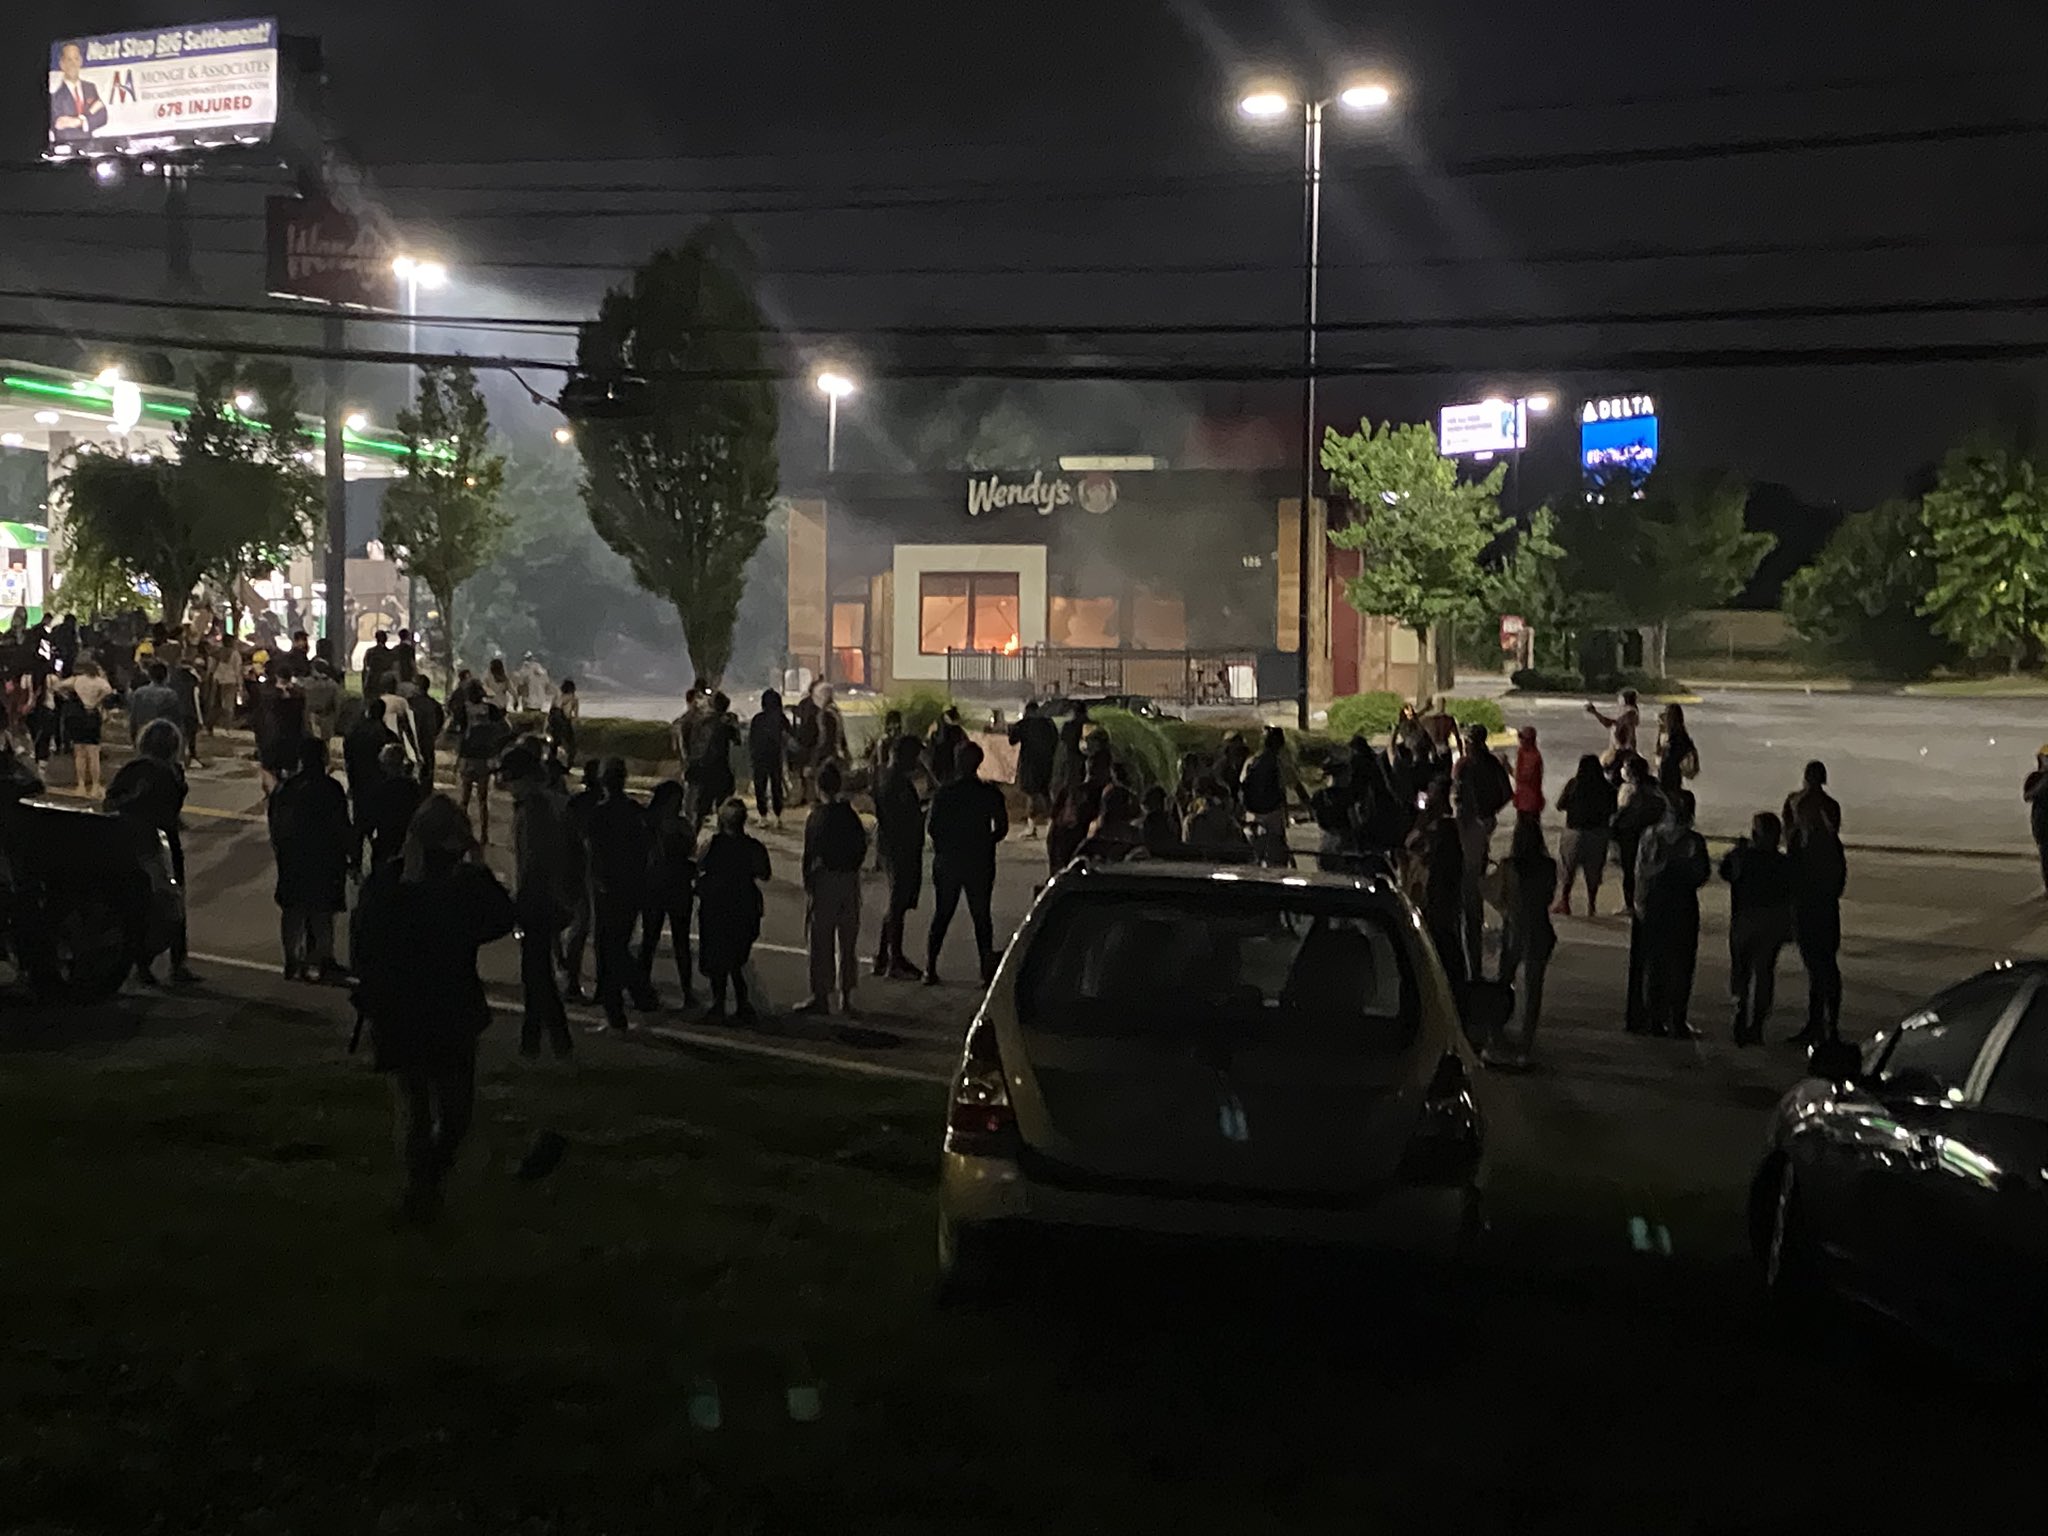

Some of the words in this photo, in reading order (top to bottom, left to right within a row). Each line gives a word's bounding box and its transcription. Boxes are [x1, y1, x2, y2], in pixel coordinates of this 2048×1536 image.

[86, 40, 121, 61] Next
[121, 37, 155, 59] Stop
[155, 32, 183, 56] BIG
[141, 67, 185, 83] MONGE
[188, 66, 197, 79] &
[200, 61, 270, 78] ASSOCIATES
[157, 101, 184, 118] 678
[188, 95, 253, 115] INJURED
[1598, 395, 1654, 420] DELTA
[967, 469, 1070, 516] Wendy's
